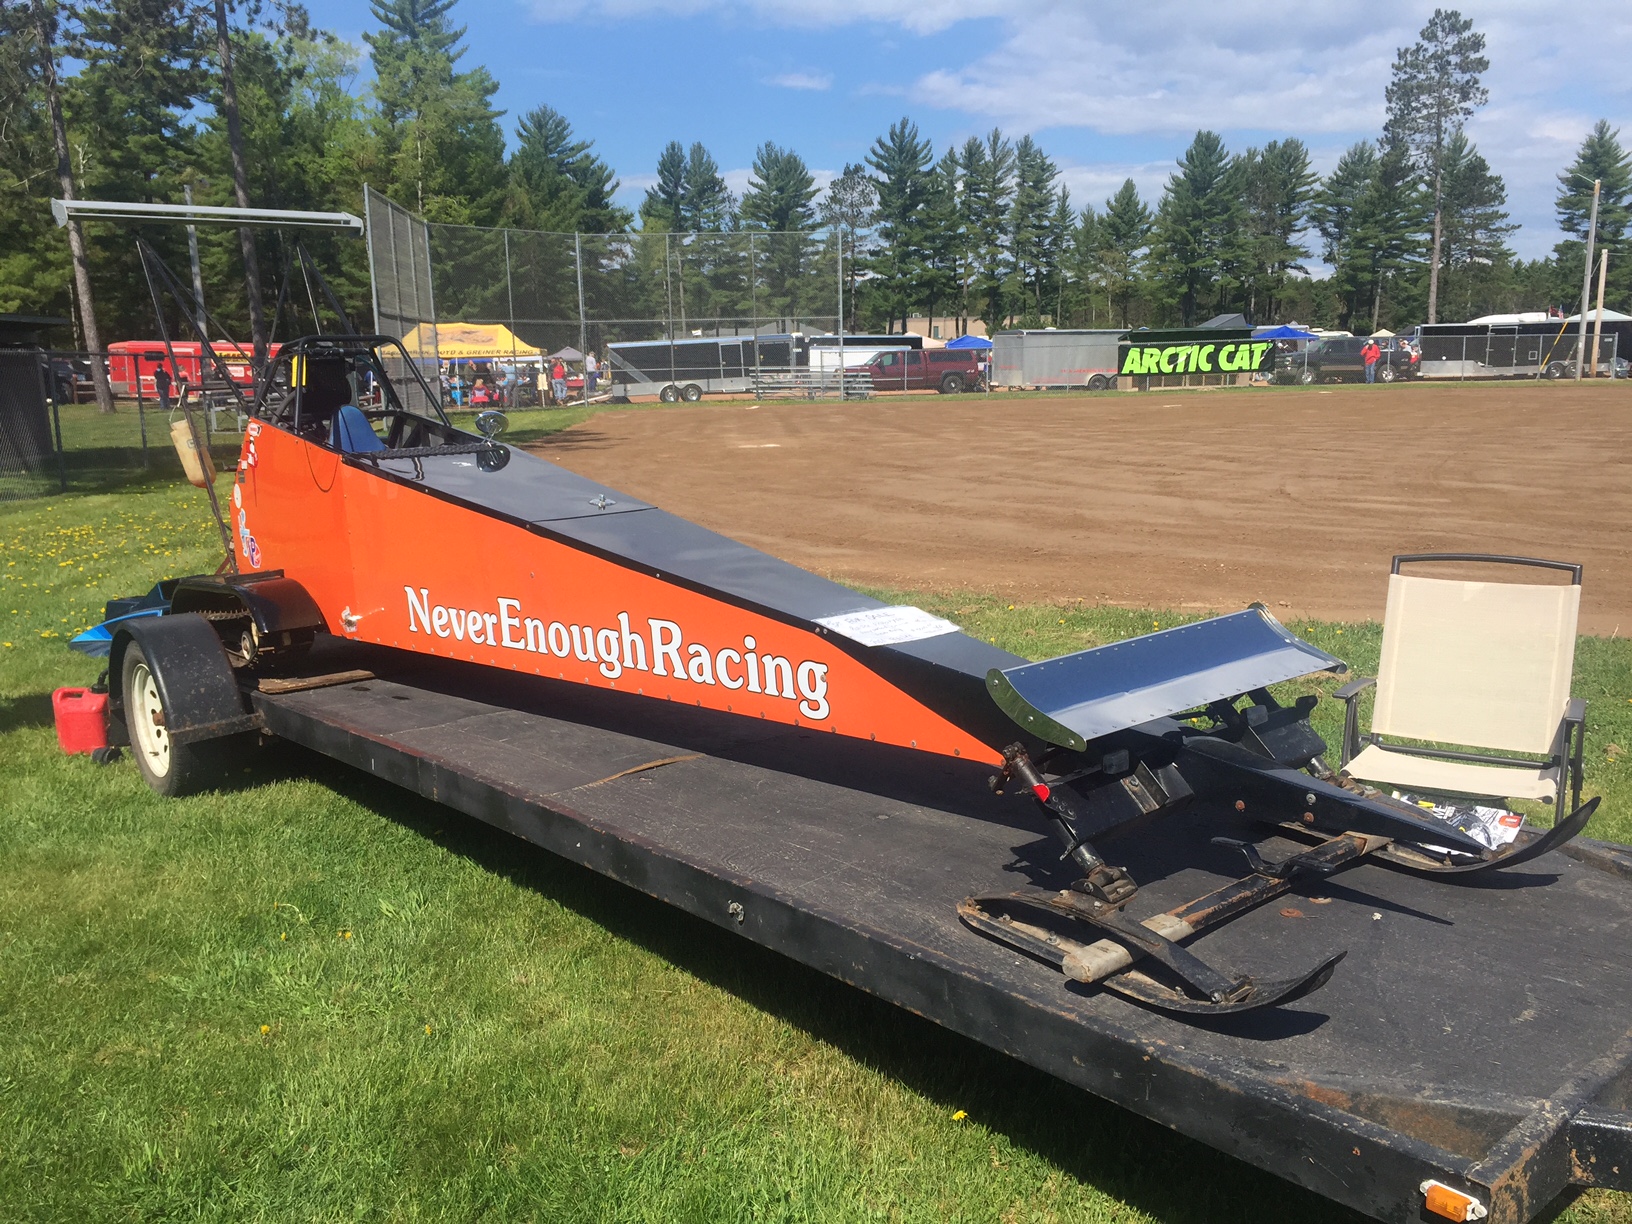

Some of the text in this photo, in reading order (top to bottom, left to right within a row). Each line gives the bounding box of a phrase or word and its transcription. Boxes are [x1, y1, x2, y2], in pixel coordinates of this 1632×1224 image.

[1121, 342, 1267, 374] ARCTIC CAT
[404, 585, 829, 720] NeverEnoughRacing
